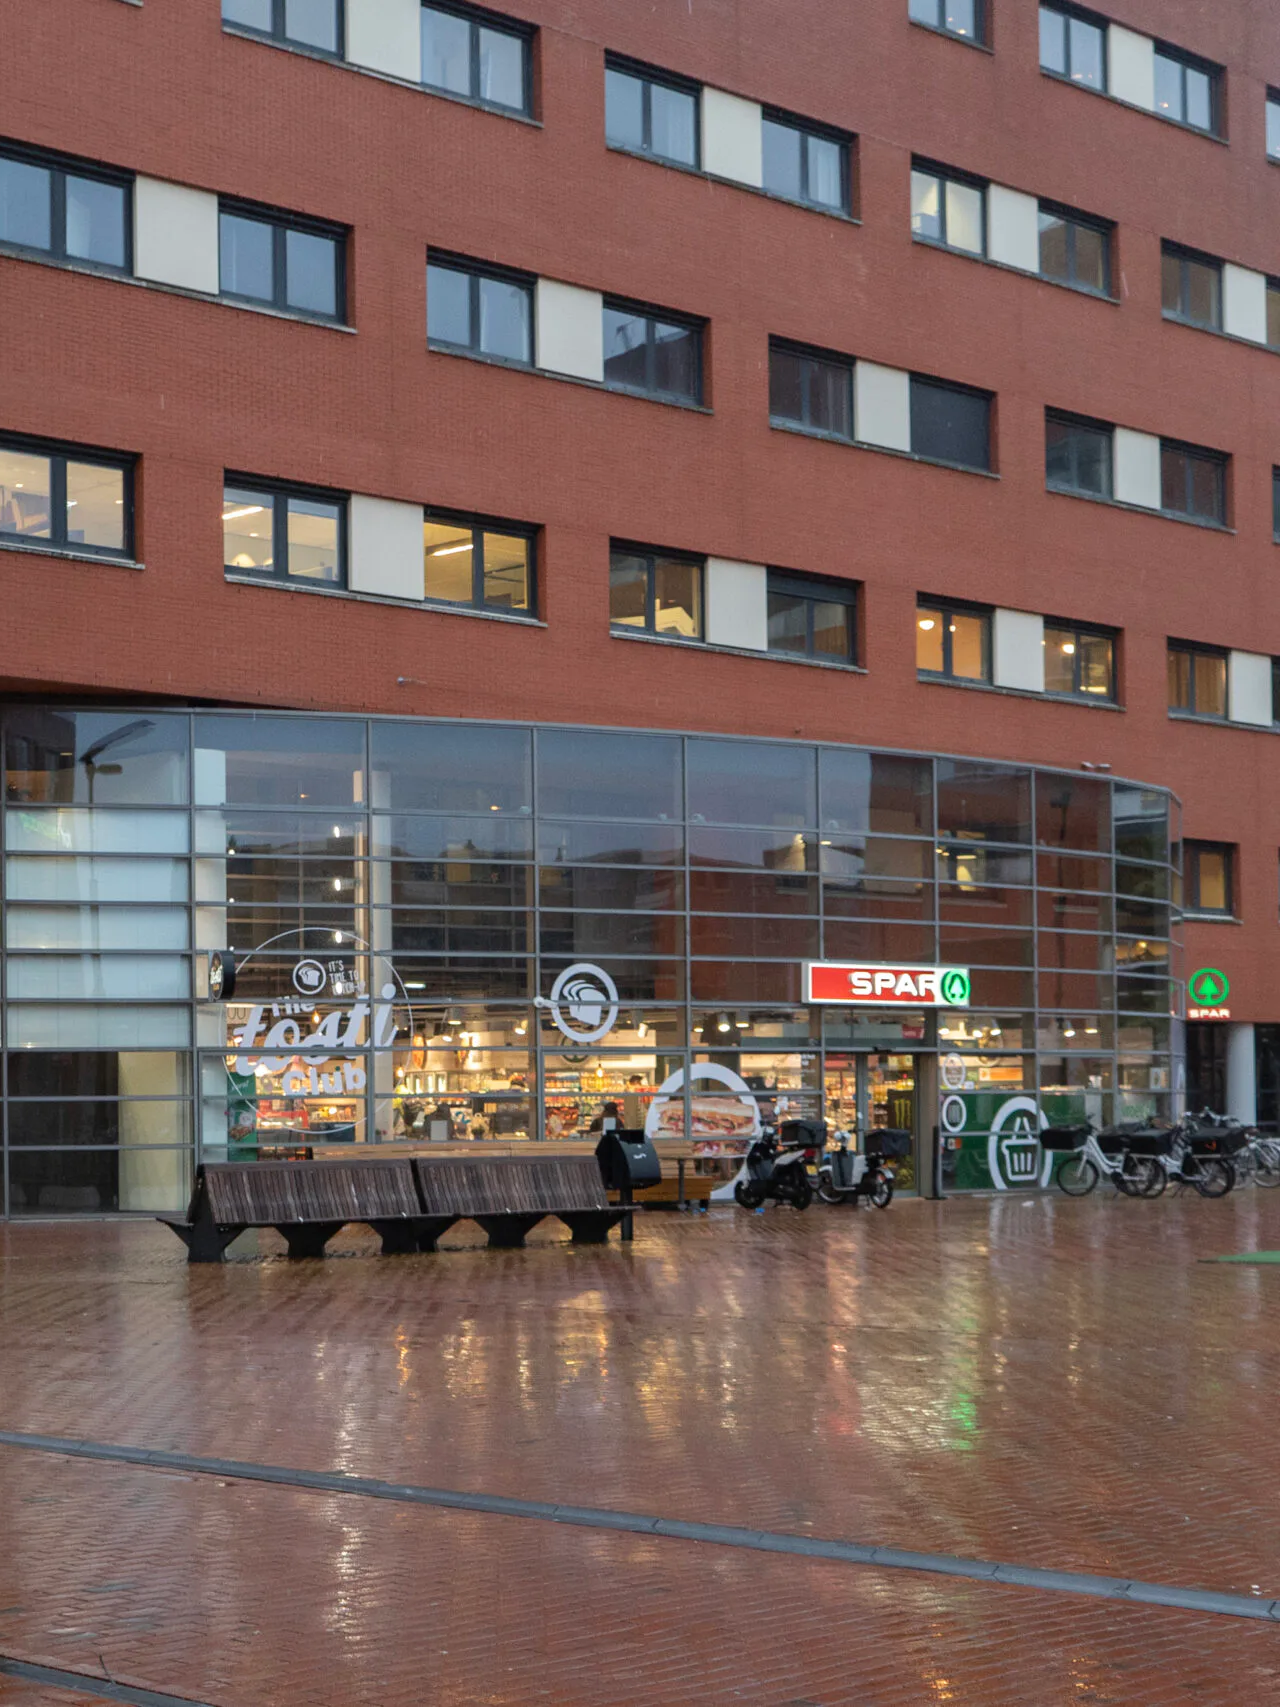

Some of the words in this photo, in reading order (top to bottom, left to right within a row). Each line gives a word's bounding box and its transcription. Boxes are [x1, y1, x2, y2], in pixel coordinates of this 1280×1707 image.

[328, 959, 345, 972] IT'S
[329, 972, 346, 985] TIME
[348, 970, 359, 981] TO
[849, 970, 936, 997] SPAR
[1187, 1008, 1231, 1019] SPAR
[233, 982, 399, 1077] tosti
